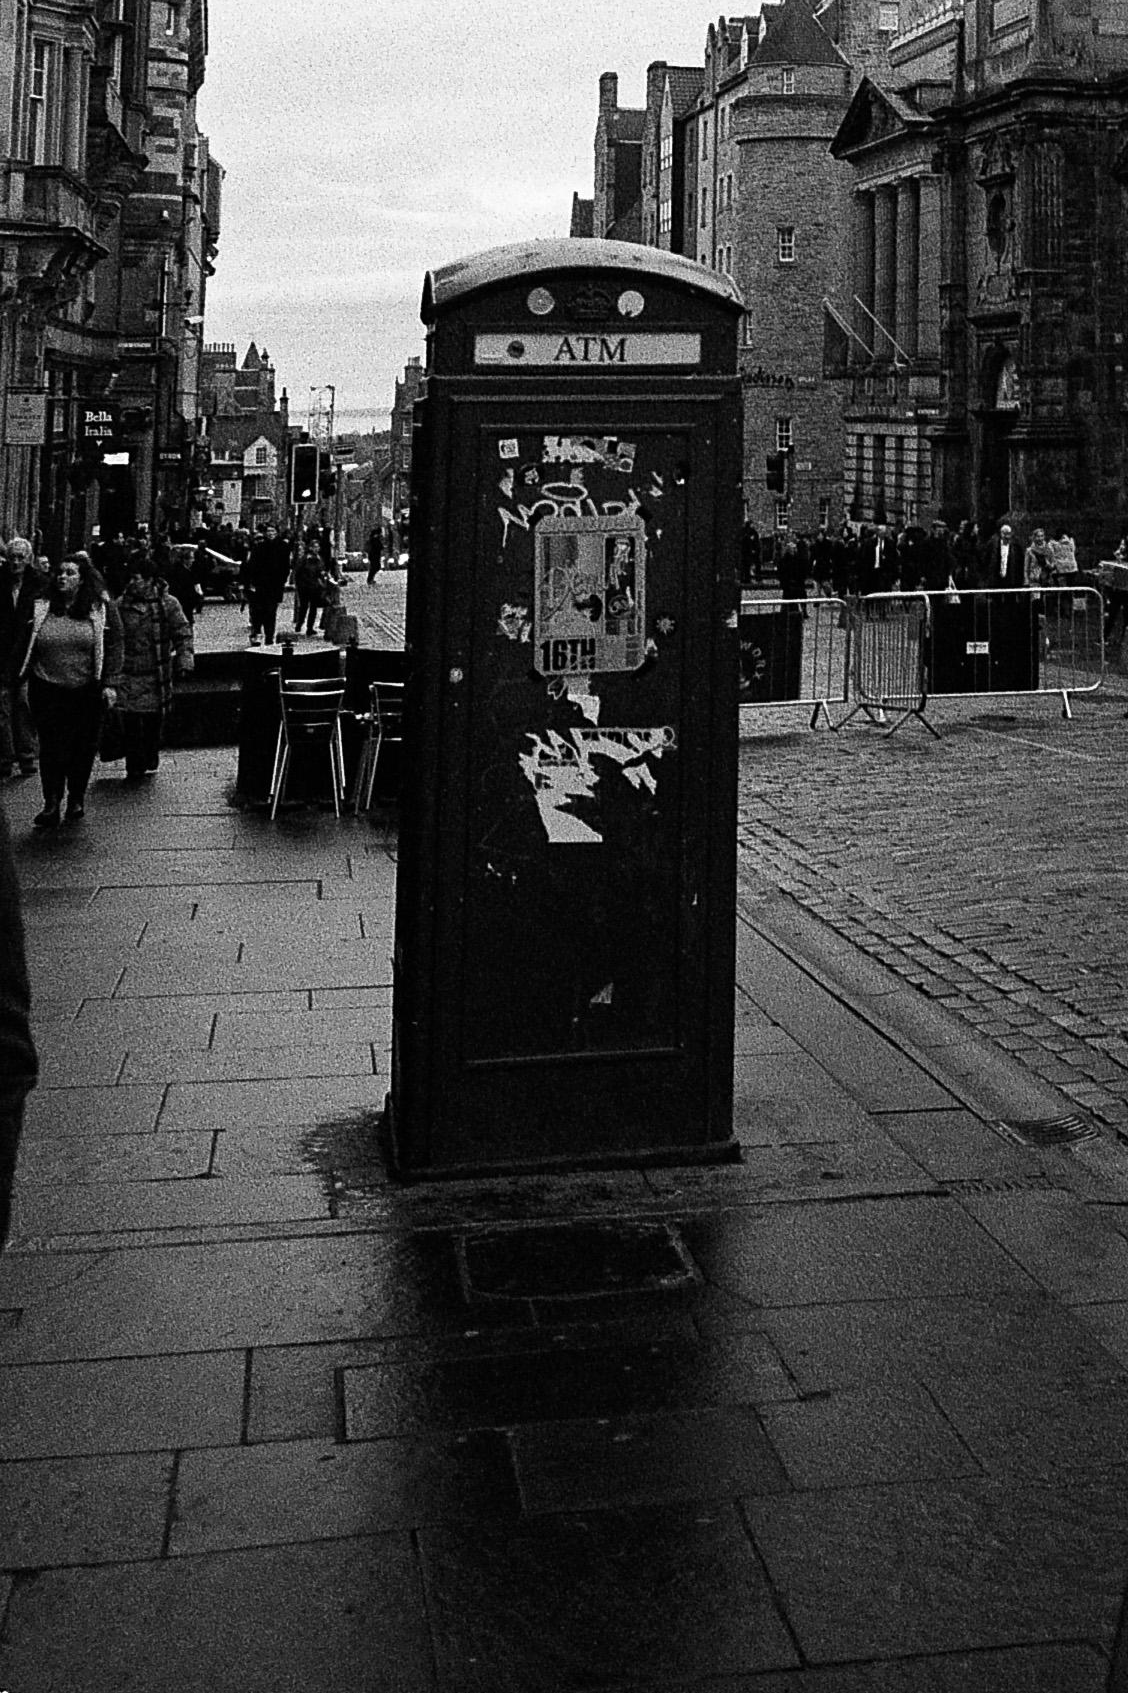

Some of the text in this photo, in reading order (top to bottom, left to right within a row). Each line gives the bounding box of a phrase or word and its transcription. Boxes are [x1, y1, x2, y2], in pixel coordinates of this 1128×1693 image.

[553, 336, 628, 362] ATM
[84, 410, 113, 423] Bella
[84, 425, 113, 437] Italia
[540, 638, 596, 671] 16TH
